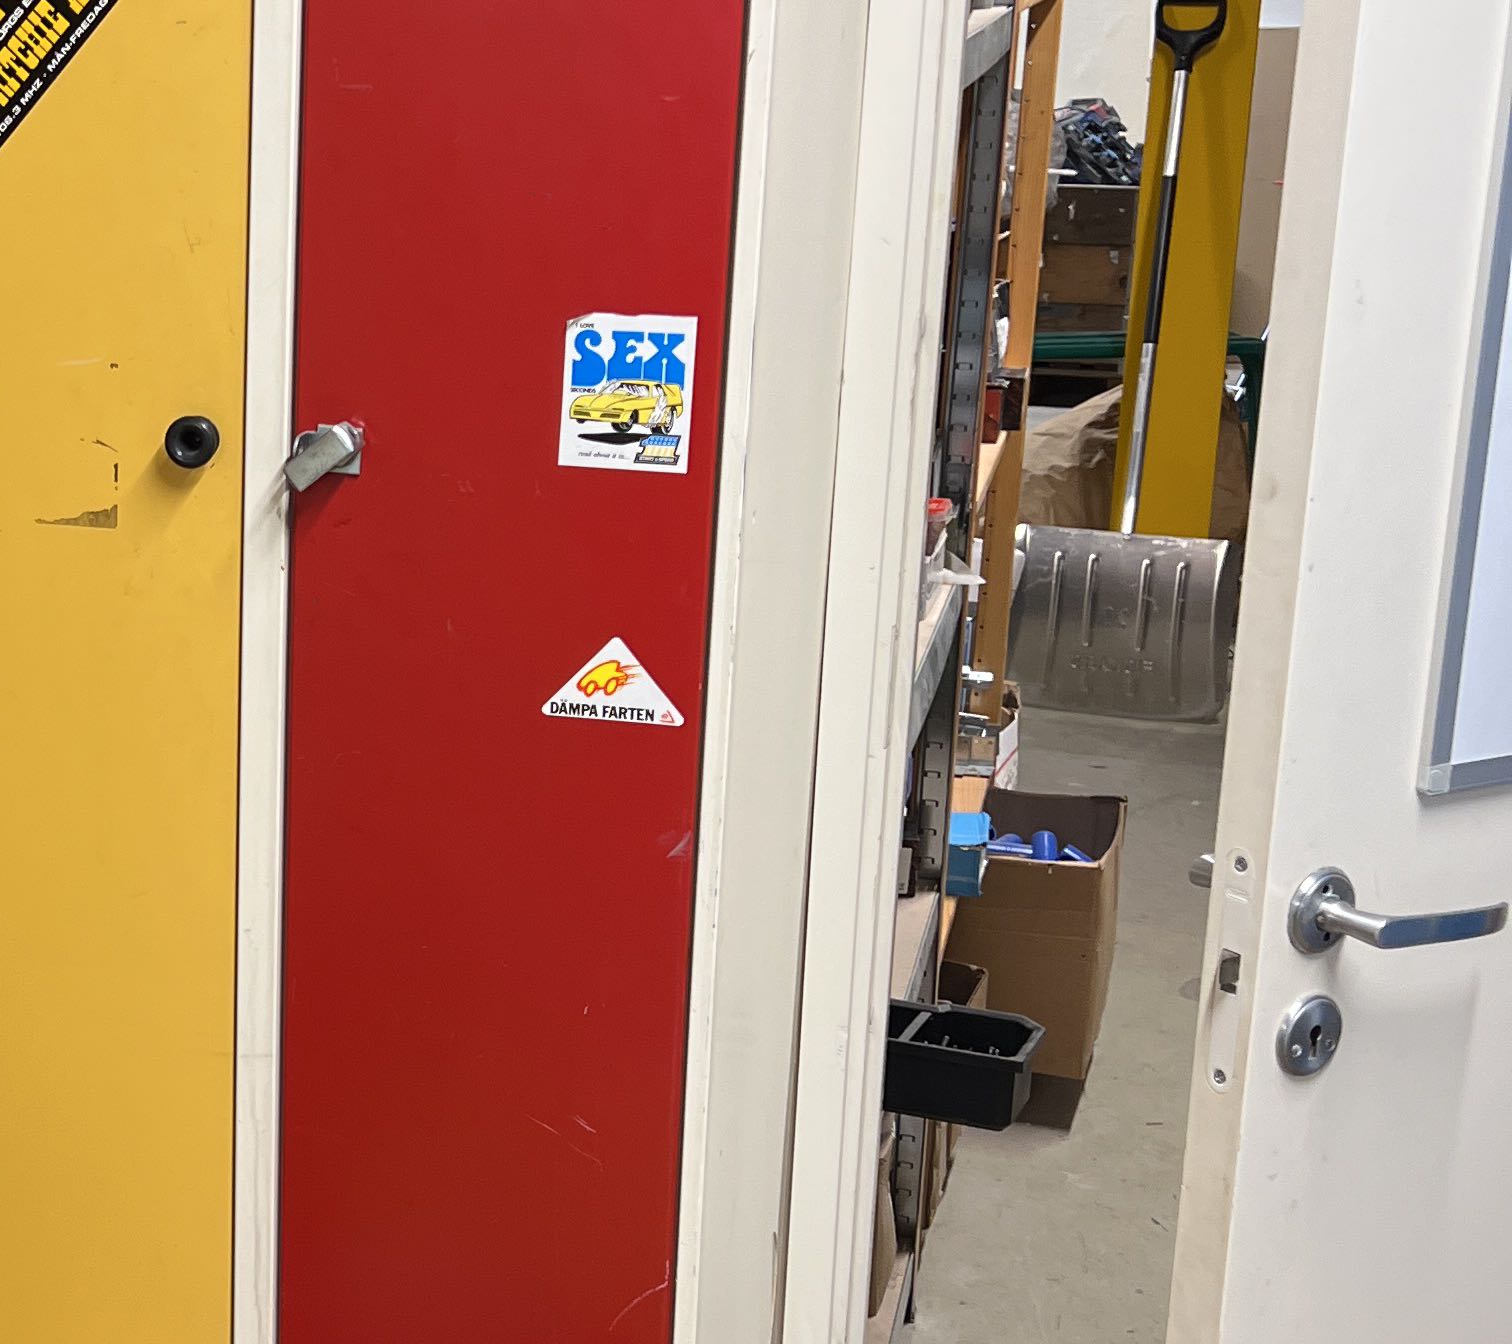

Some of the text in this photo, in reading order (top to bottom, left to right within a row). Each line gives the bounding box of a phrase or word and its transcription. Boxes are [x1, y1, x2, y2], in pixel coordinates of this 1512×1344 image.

[19, 77, 44, 106] MHZ
[572, 329, 686, 391] SEX
[550, 699, 655, 722] DÄMPA FARTEN
